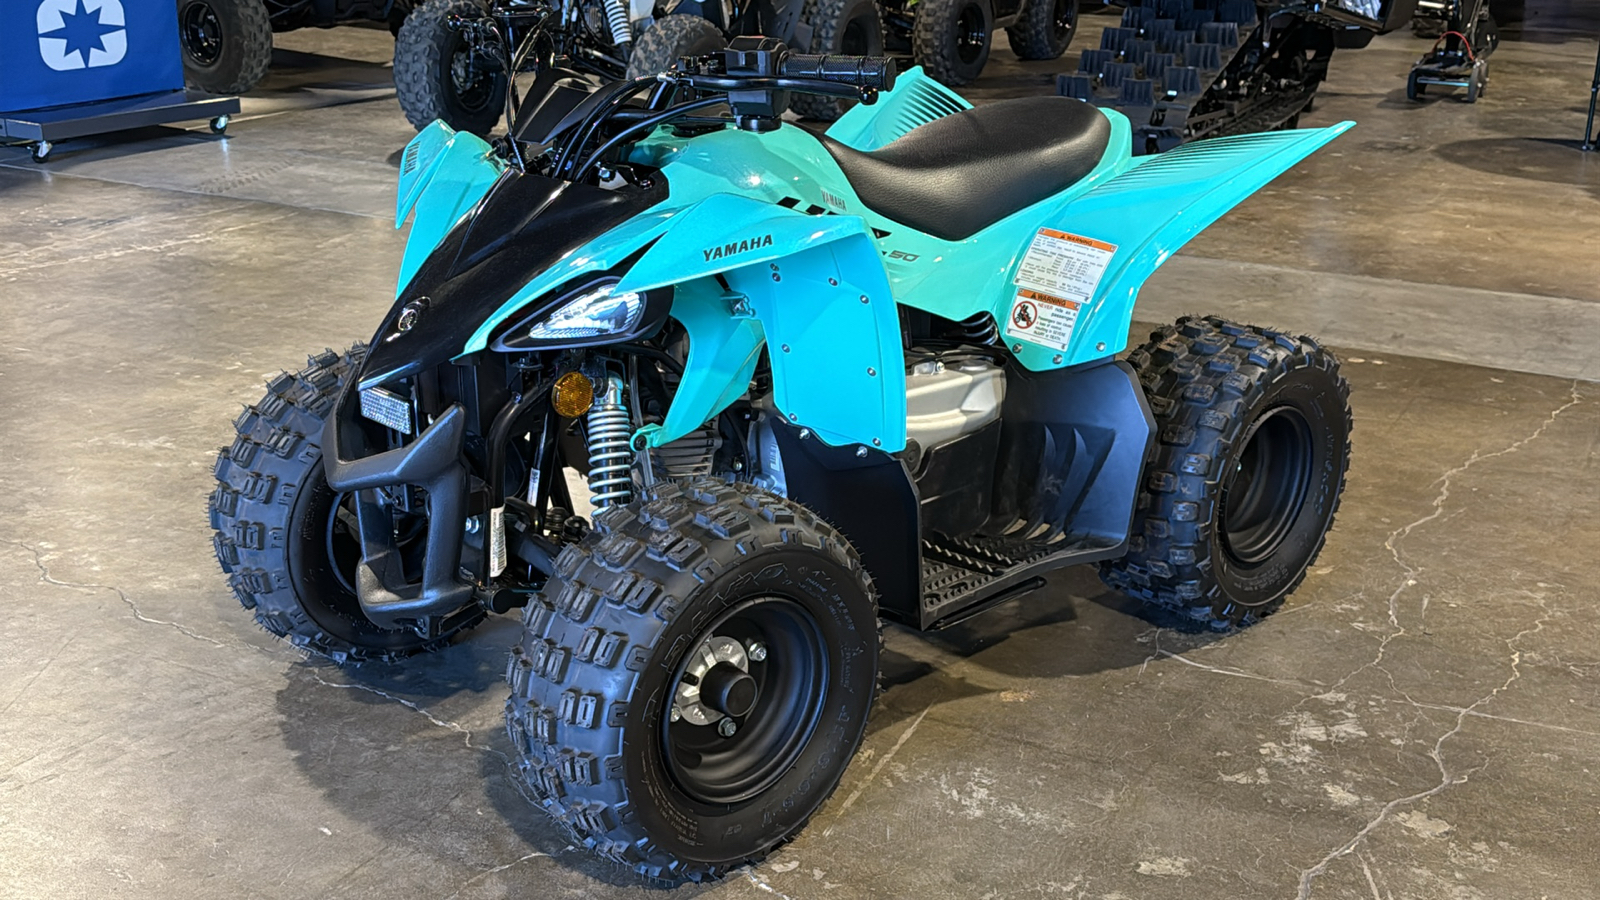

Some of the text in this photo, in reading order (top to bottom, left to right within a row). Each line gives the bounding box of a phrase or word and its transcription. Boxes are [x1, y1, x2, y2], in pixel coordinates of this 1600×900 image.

[402, 140, 421, 177] YAMAHA
[821, 189, 847, 212] YAMAHA
[703, 234, 773, 262] YAMAHA
[1066, 236, 1093, 245] WARNING
[888, 250, 920, 262] 50
[1037, 293, 1066, 305] WARNING
